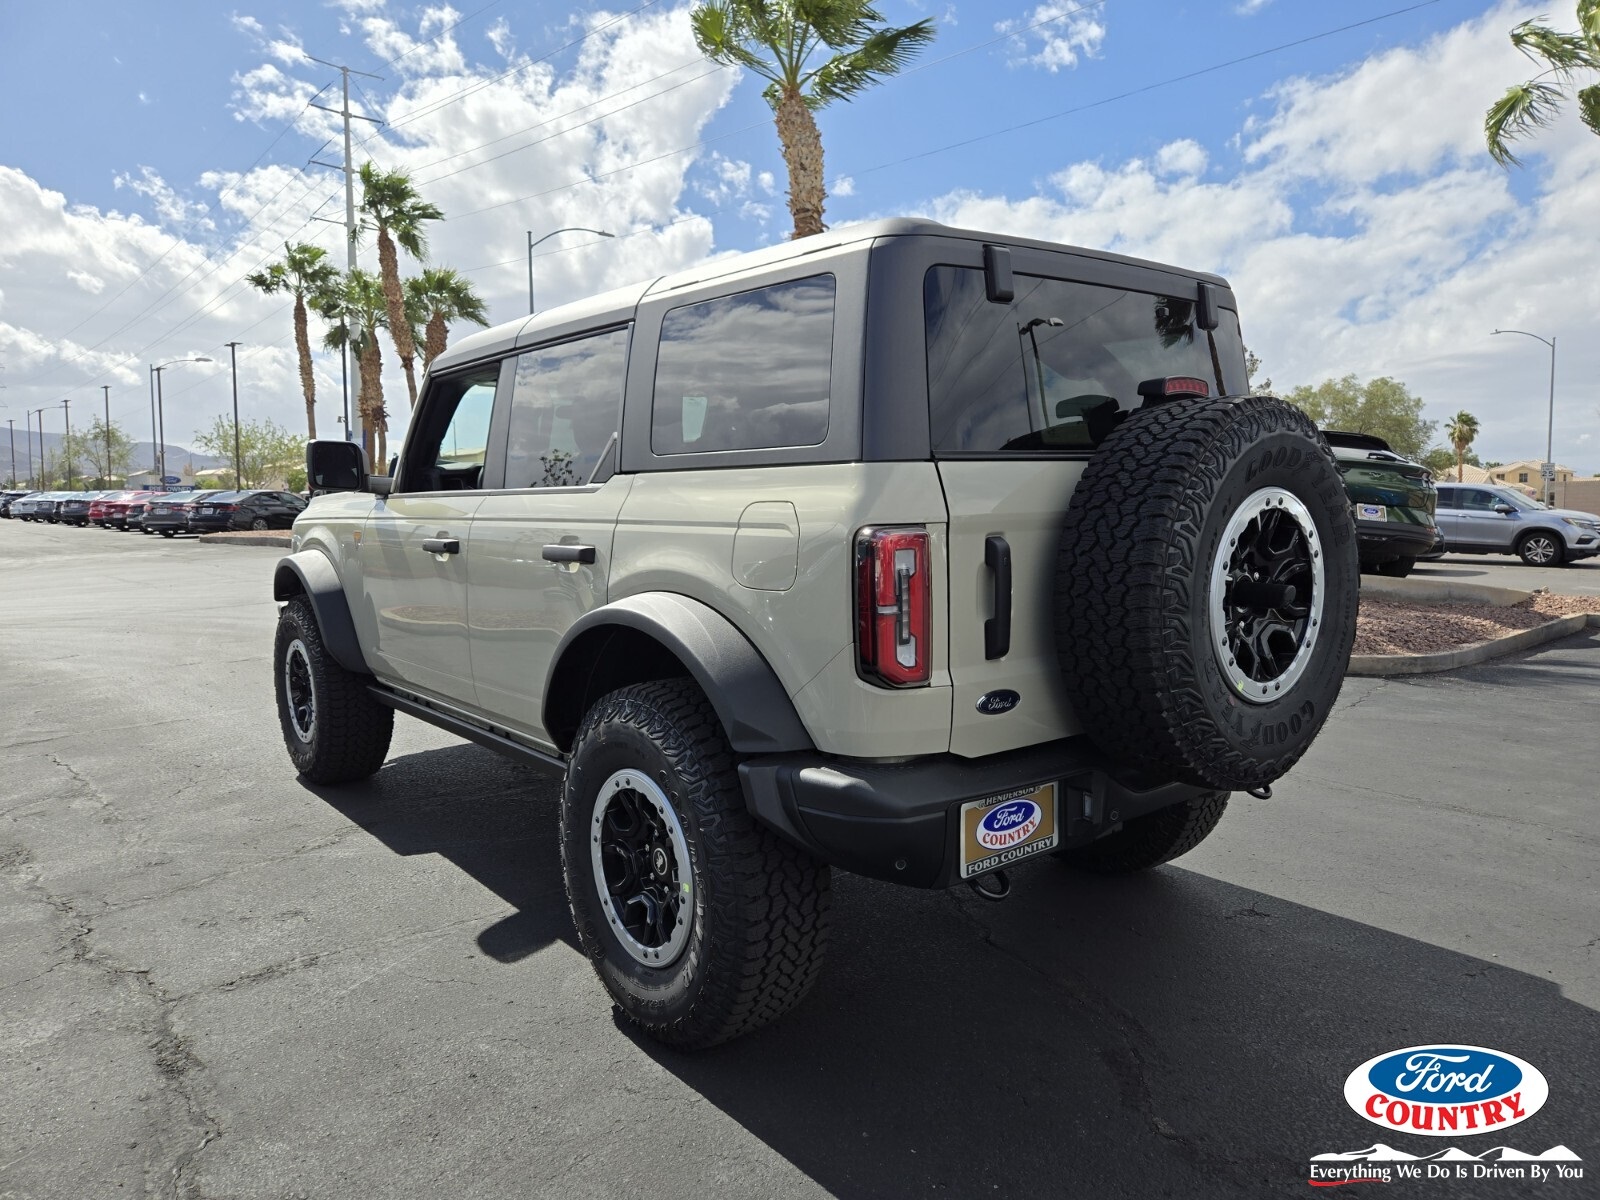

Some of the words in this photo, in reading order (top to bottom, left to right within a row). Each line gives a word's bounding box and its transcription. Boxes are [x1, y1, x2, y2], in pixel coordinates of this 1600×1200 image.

[988, 697, 1012, 710] Ford
[993, 805, 1025, 829] Ford
[982, 817, 1037, 846] COUNTRY
[968, 856, 999, 874] FORD
[1001, 837, 1052, 862] COUNTRY
